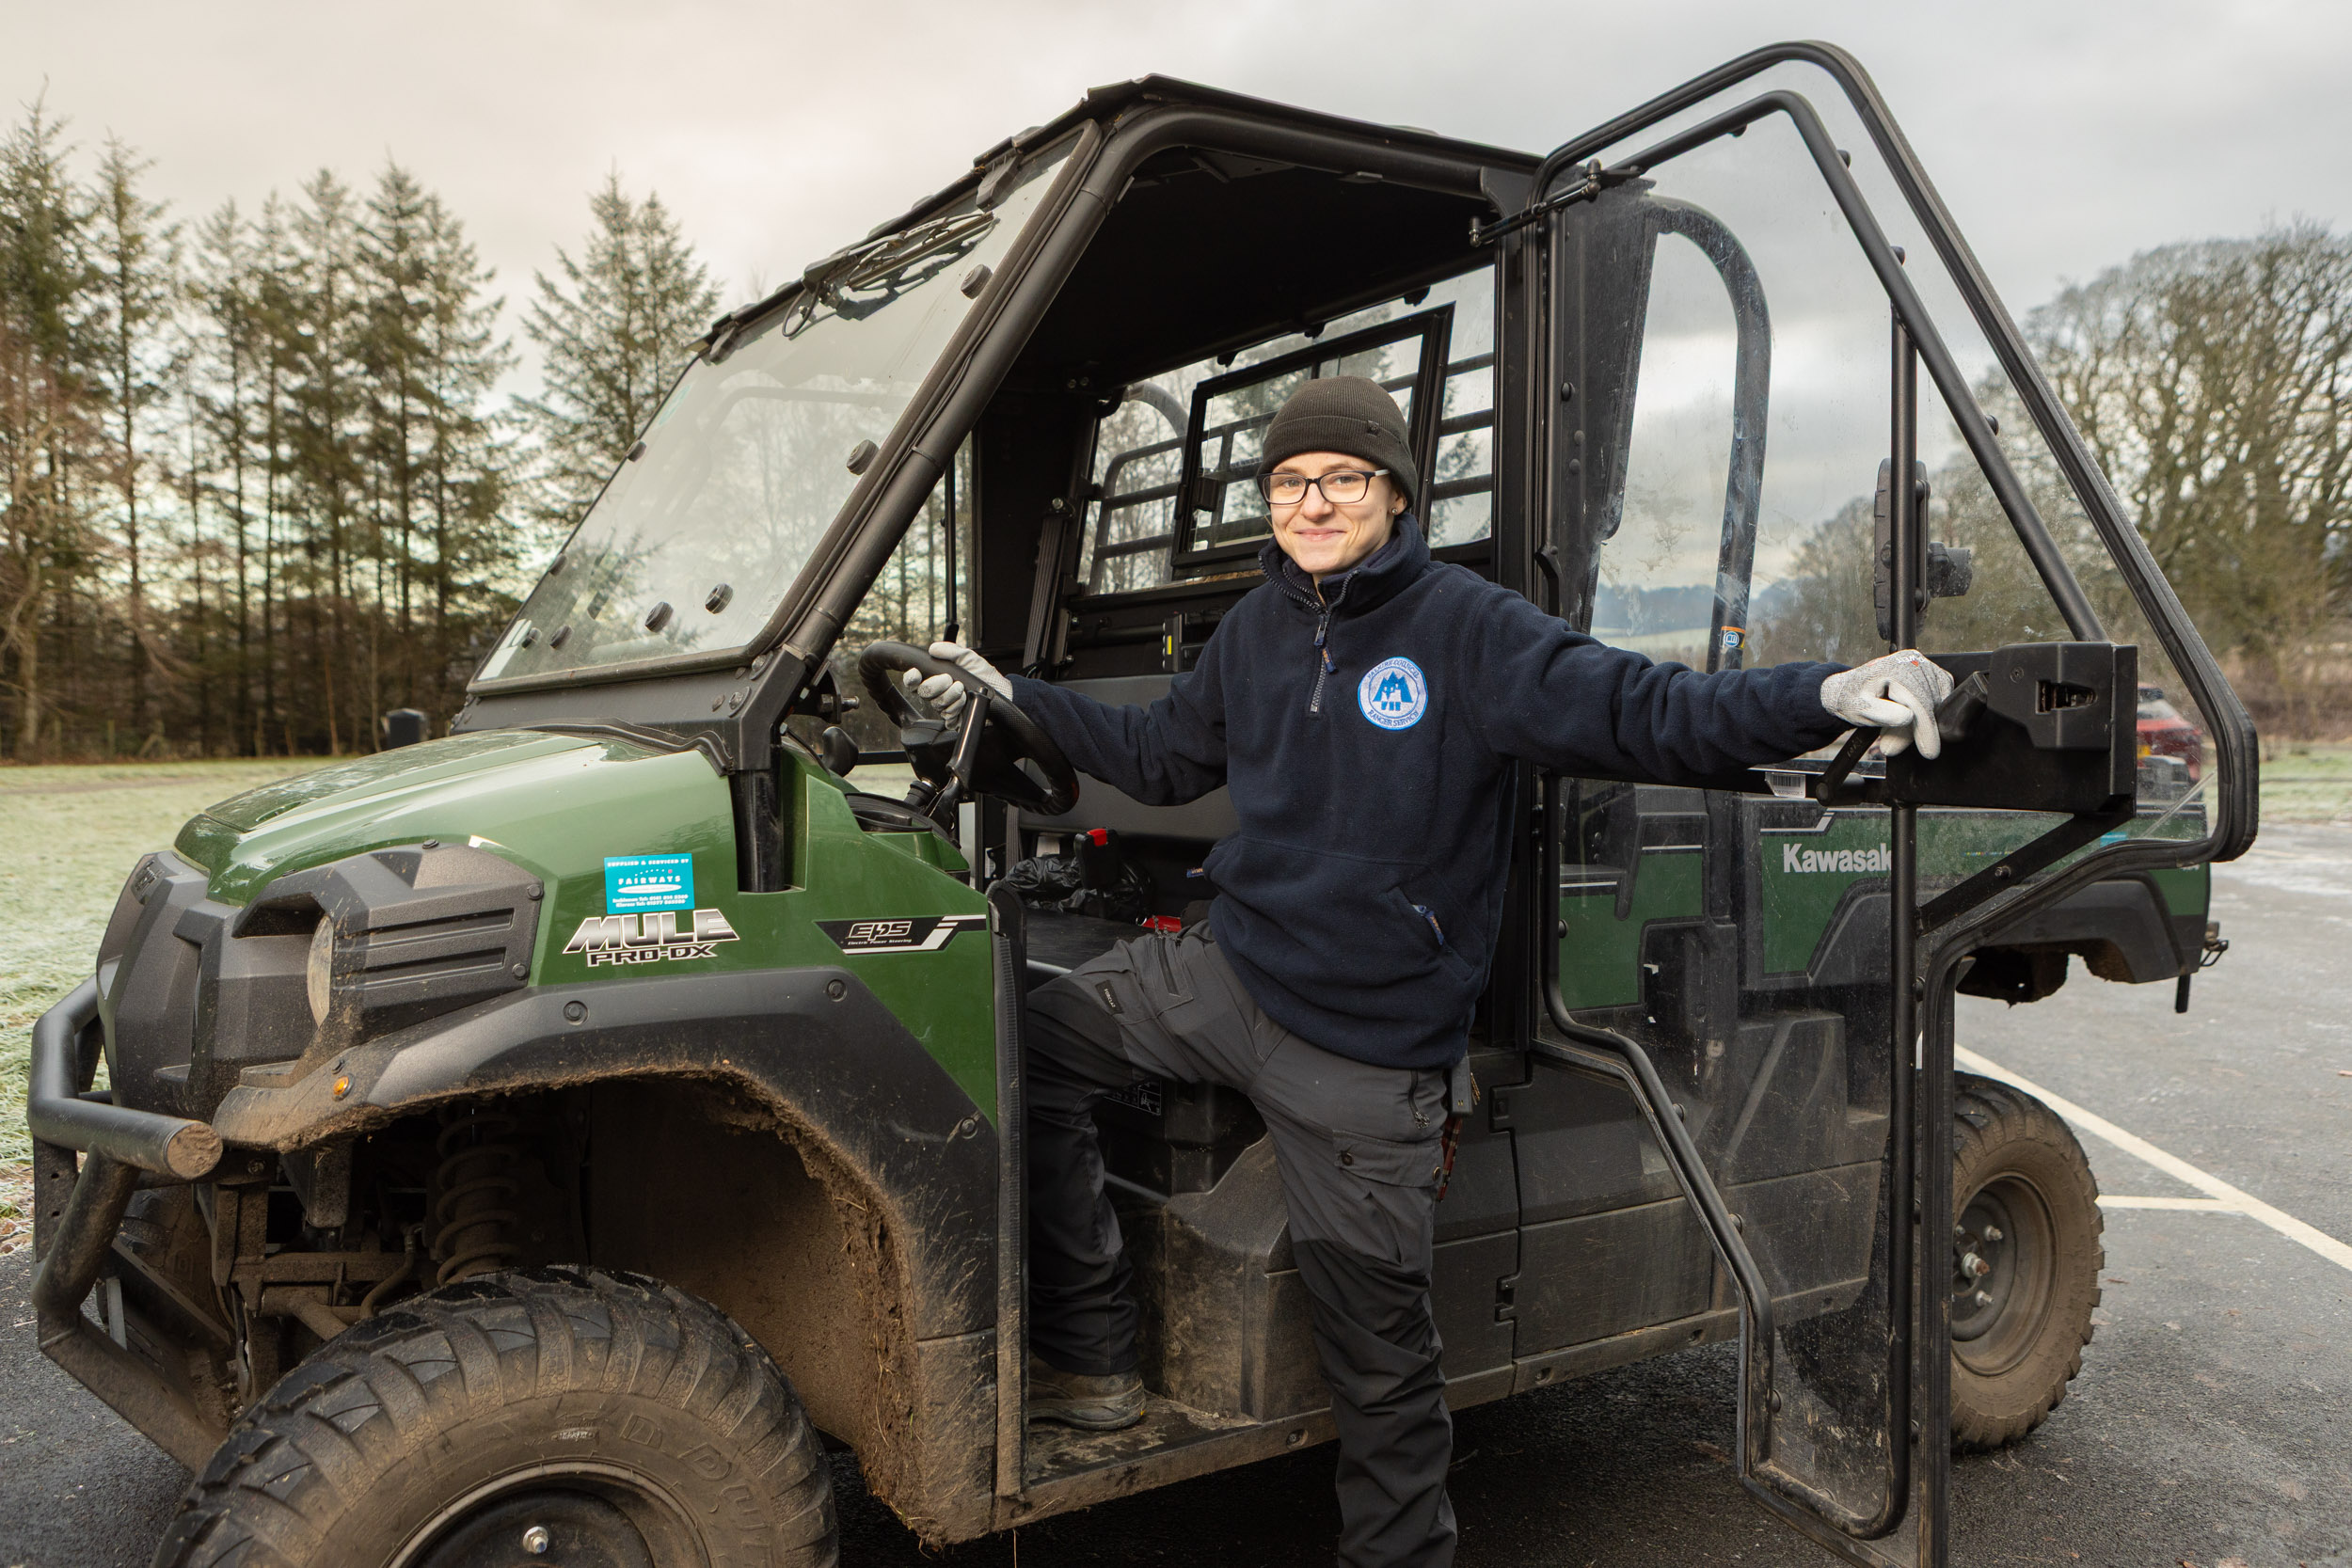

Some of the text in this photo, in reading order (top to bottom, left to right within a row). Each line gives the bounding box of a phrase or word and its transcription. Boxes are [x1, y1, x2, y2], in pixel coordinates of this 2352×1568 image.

[1393, 659, 1420, 678] COUNCIL
[1367, 709, 1419, 726] RANGER SERVICE
[1783, 843, 1892, 873] Kawasak
[617, 875, 681, 885] FAIRWAYS
[563, 909, 740, 954] MULE
[849, 921, 912, 941] EPS
[587, 942, 718, 967] PRO-DX
